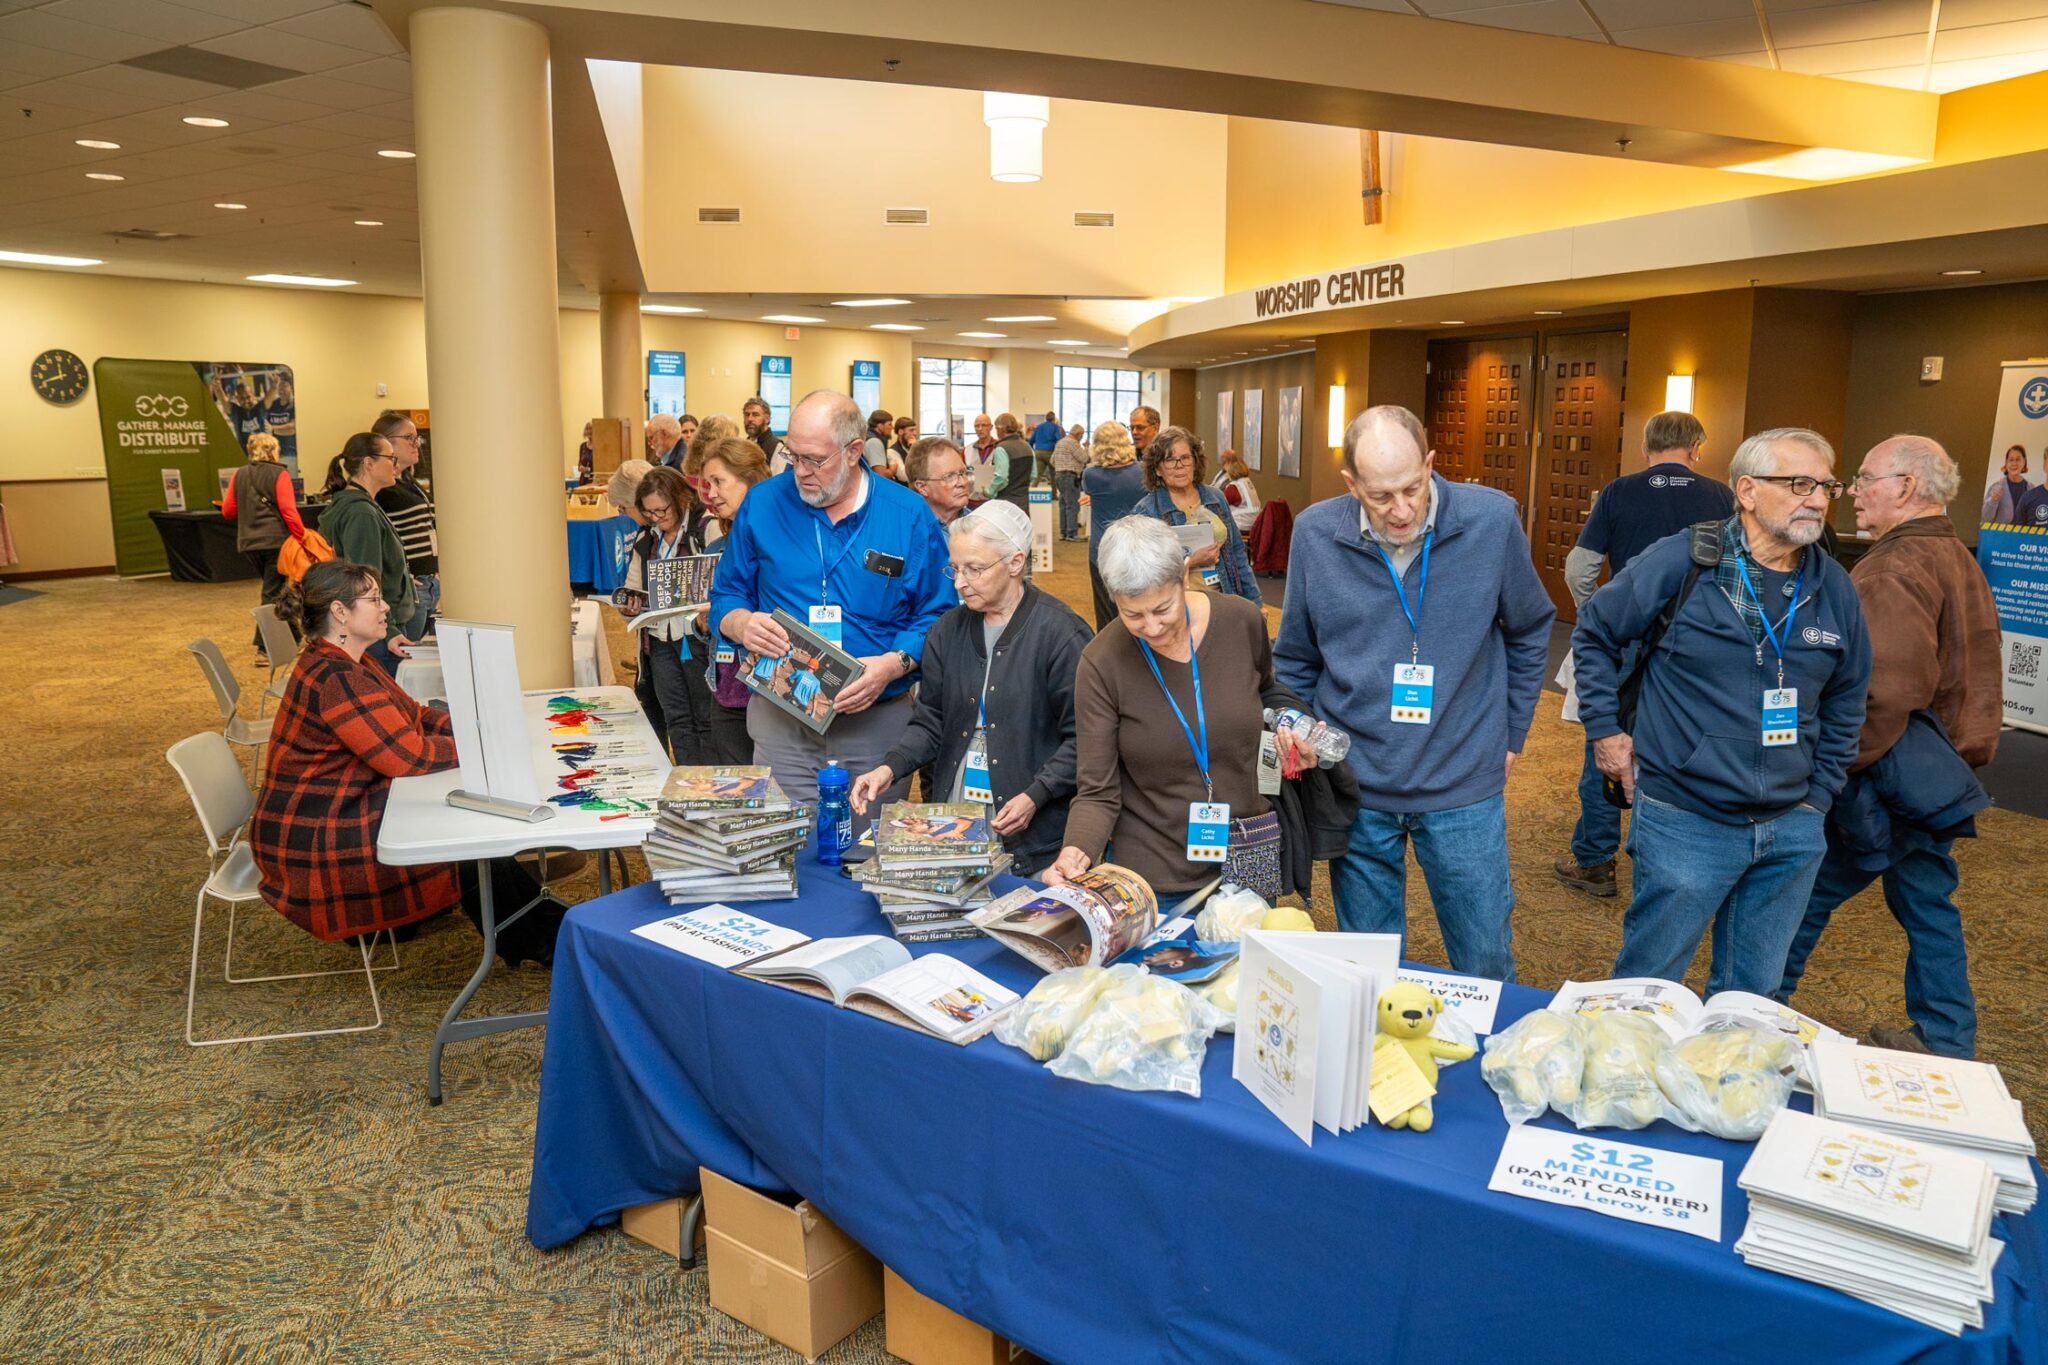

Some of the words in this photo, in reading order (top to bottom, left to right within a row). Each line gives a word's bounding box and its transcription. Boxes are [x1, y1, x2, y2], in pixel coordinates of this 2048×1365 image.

[1255, 278, 1321, 318] WORSHIP
[1326, 263, 1404, 306] CENTER
[1147, 371, 1156, 391] 1
[117, 421, 162, 430] GATHER.
[164, 421, 208, 430] MANAGE.
[120, 432, 210, 446] DISTRIBUTE.
[2020, 544, 2037, 553] OUR
[2011, 579, 2028, 588] OUR
[665, 590, 671, 604] OF
[2001, 588, 2024, 597] respond
[2008, 677, 2035, 687] Volunteer
[730, 821, 747, 829] Many
[736, 843, 752, 852] Many
[753, 838, 770, 847] Hands
[747, 860, 760, 869] Many
[761, 855, 774, 864] Hands
[719, 917, 770, 936] $24
[663, 921, 688, 932] (PAY
[702, 935, 755, 957] CASHIER)
[676, 916, 720, 933] MANY
[720, 931, 773, 952] HANDS
[1440, 981, 1478, 992] Bear,
[1452, 991, 1489, 1001] (PAY
[1570, 1142, 1654, 1173] $12
[1544, 1159, 1675, 1193] MENDED
[1508, 1165, 1557, 1182] (PAY
[1563, 1177, 1593, 1188] AT
[1598, 1183, 1709, 1214] CASHIER)
[1521, 1179, 1576, 1198] Bear,
[1661, 1207, 1690, 1220] $8
